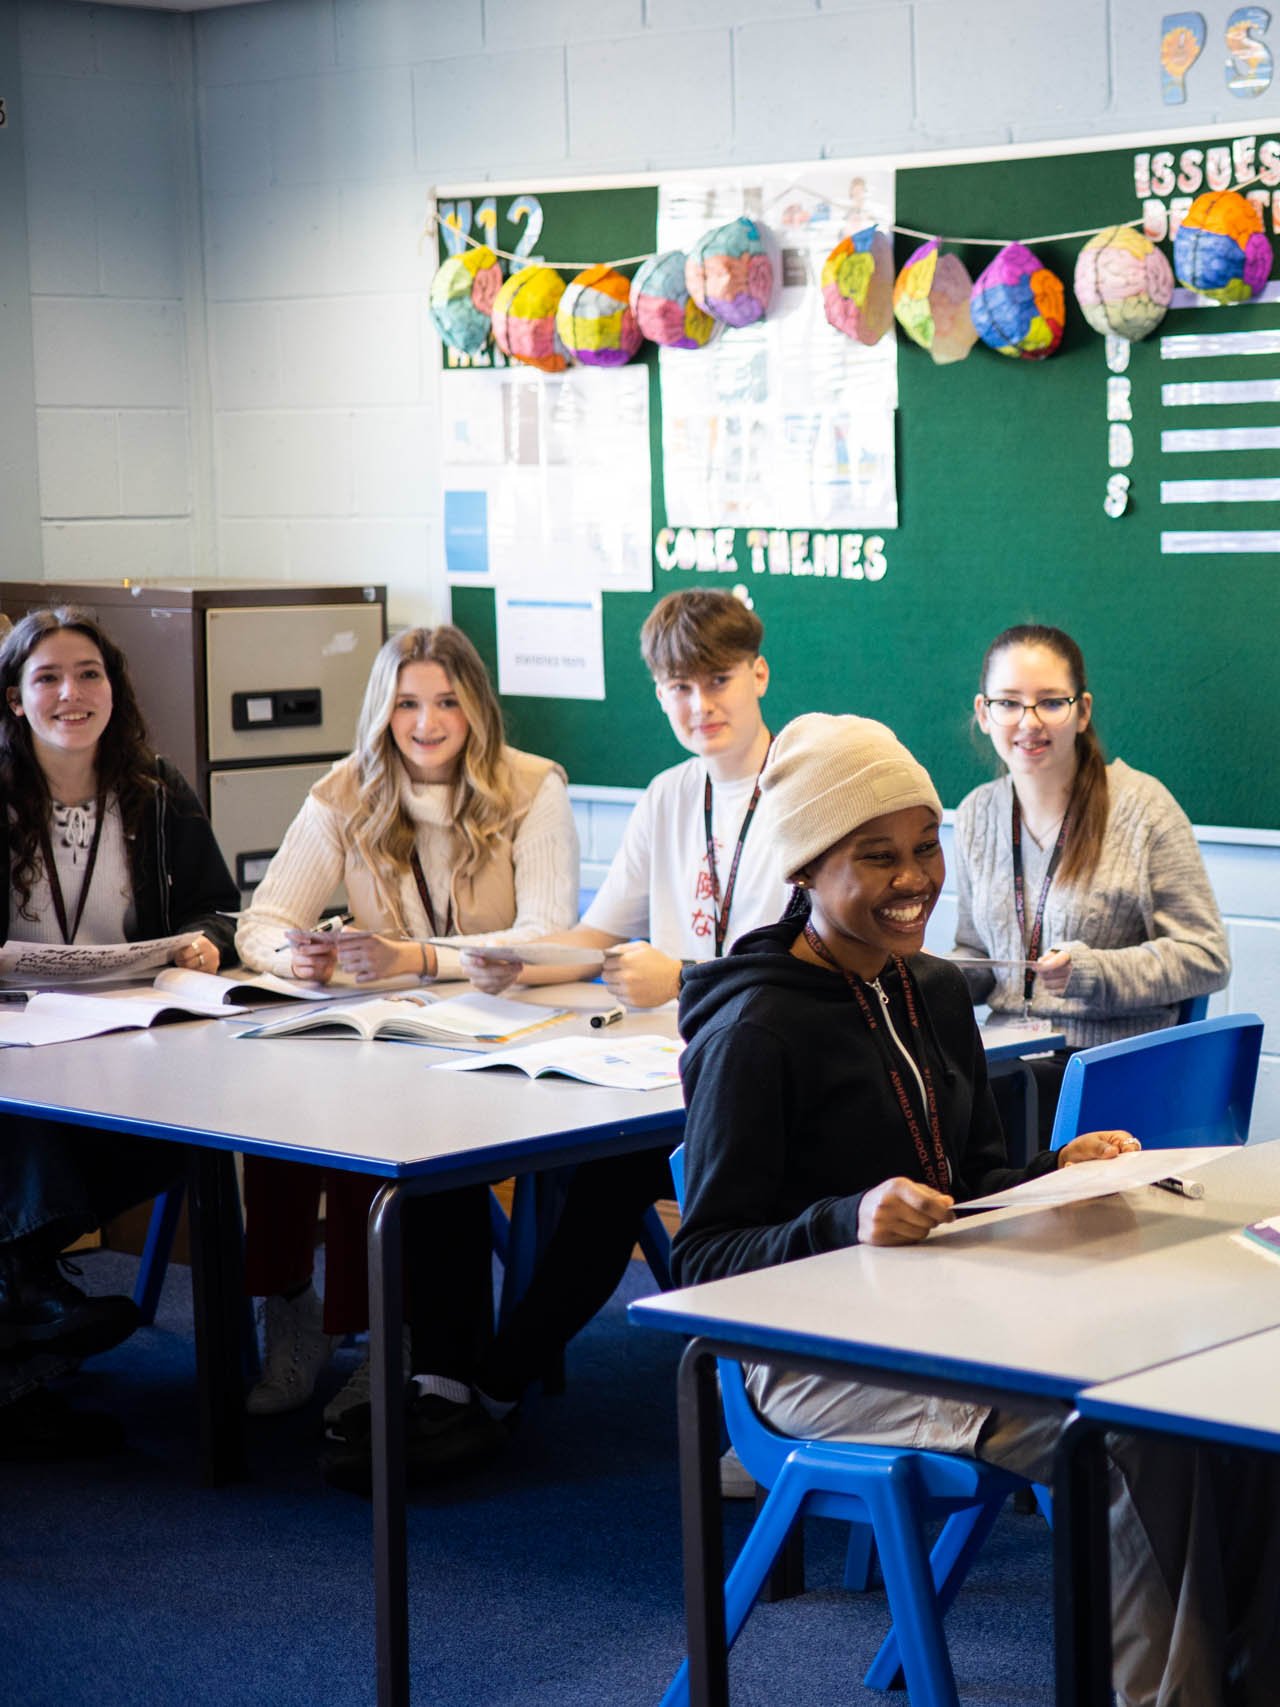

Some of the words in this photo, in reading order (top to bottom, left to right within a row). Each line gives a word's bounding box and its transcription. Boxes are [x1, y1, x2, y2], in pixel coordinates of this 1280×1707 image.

[438, 195, 544, 275] Y12
[655, 527, 738, 572] CORE
[746, 528, 887, 582] THEMES
[889, 1069, 913, 1120] ASHFIELD
[907, 1117, 929, 1167] SCHOOL
